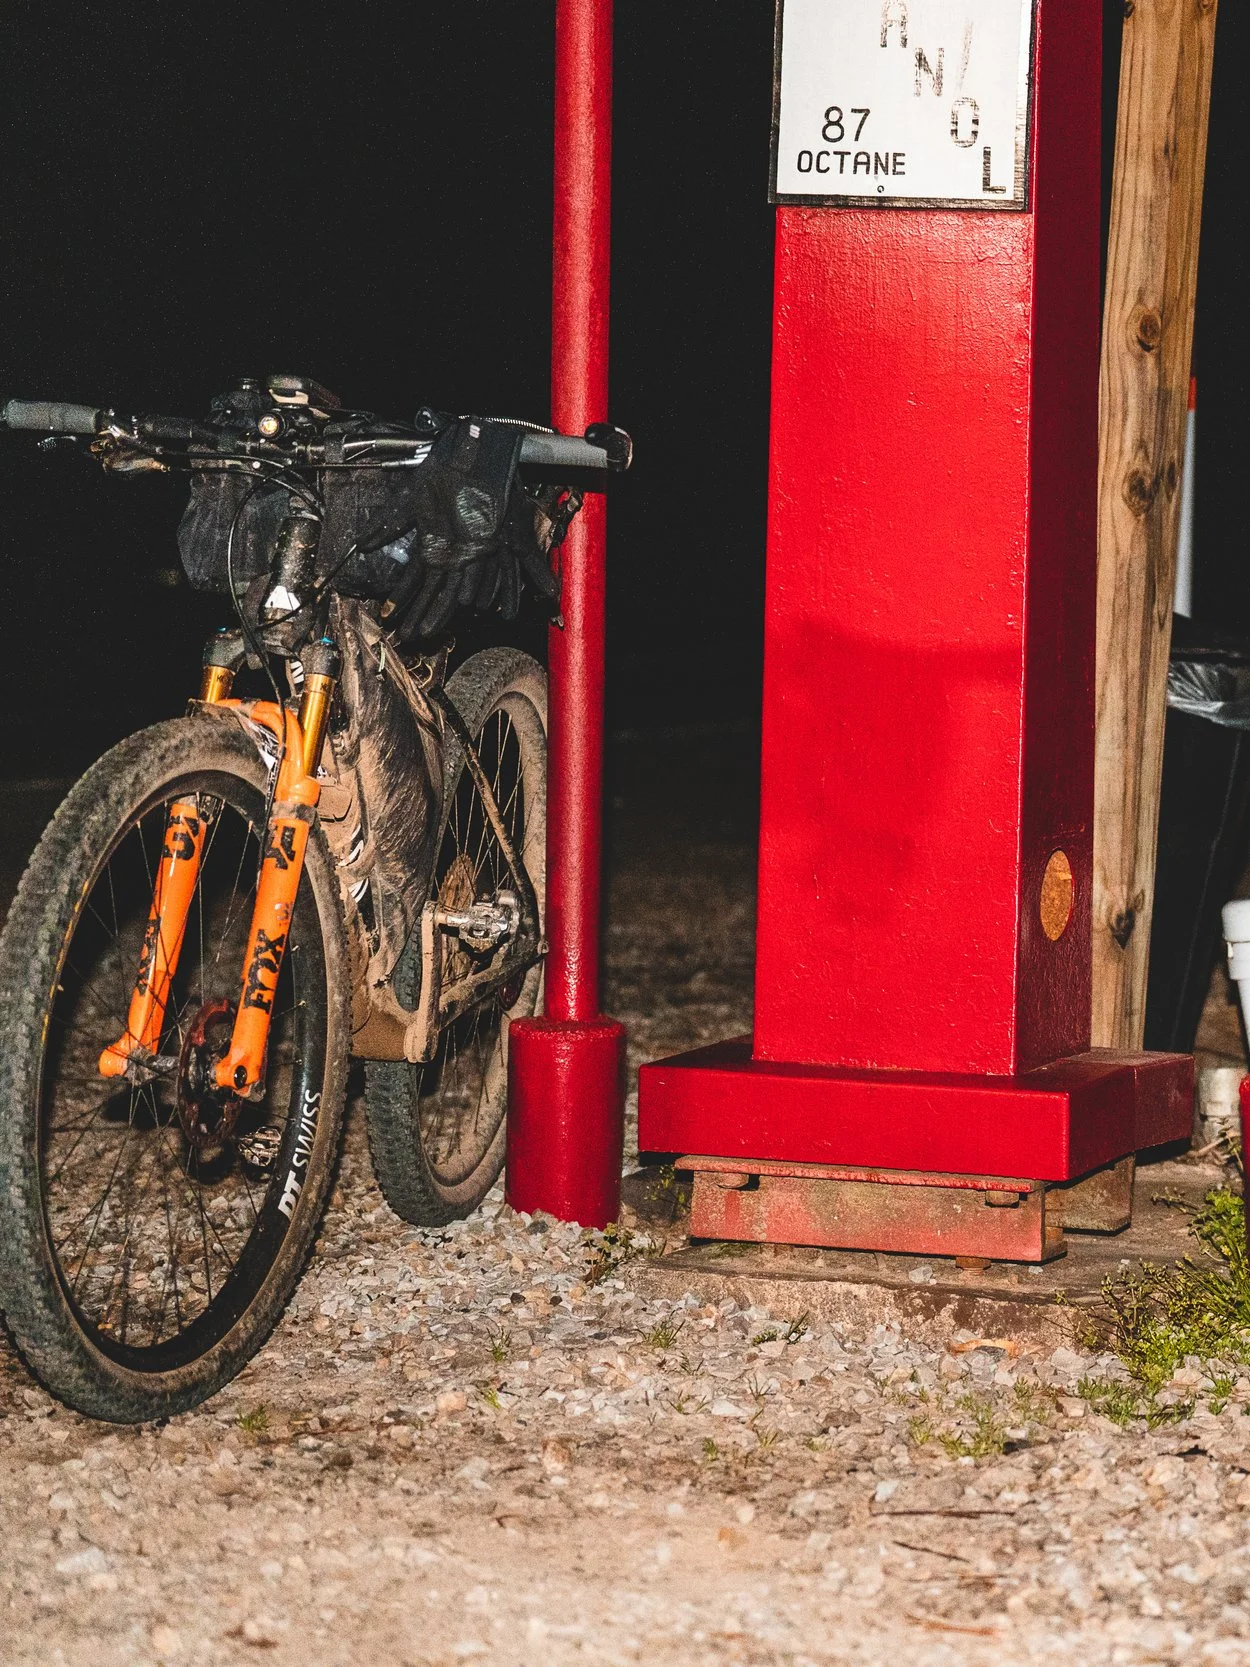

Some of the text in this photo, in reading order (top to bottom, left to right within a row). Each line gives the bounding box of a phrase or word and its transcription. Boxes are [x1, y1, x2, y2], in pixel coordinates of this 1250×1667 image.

[821, 105, 871, 143] 87
[796, 149, 906, 176] OCTANE
[243, 928, 286, 1014] FOX
[292, 1089, 322, 1168] SWISS
